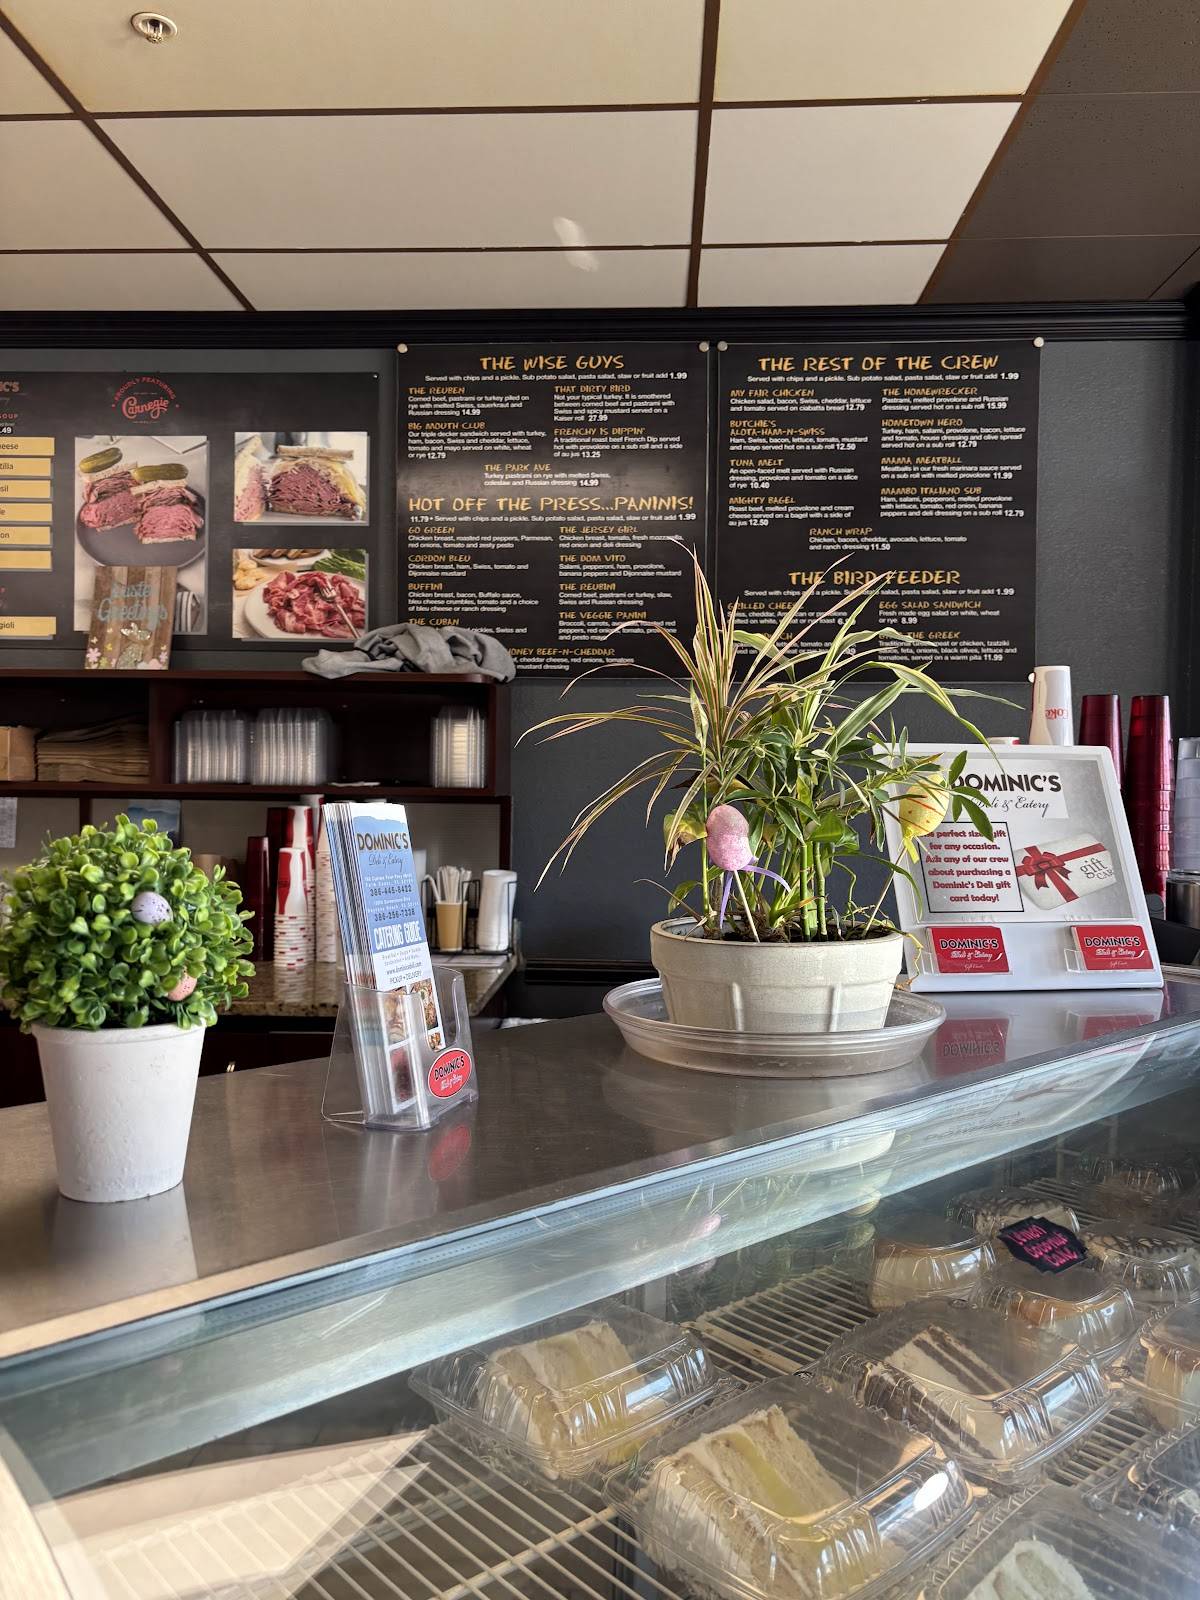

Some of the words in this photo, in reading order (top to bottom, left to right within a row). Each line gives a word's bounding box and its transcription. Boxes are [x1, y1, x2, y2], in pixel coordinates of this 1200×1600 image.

[480, 356, 515, 371] THE
[524, 356, 568, 370] WISE
[576, 355, 624, 370] GUYS
[759, 356, 794, 371] THE
[803, 356, 853, 371] REST
[862, 355, 887, 371] OF
[896, 355, 932, 370] THE
[941, 354, 999, 370] CREW
[114, 378, 140, 402] PROUDLY
[141, 376, 176, 400] FEATURING
[409, 387, 426, 395] THE
[429, 387, 465, 395] REUBEN
[554, 385, 575, 393] THAT
[580, 385, 606, 393] DIRTY
[610, 385, 630, 393] BIRD
[731, 389, 745, 397] MY
[749, 389, 768, 397] FAIR
[772, 389, 814, 397] CHICKEN
[883, 387, 900, 395] THE
[904, 387, 977, 395] HOMEWRECKER
[122, 396, 169, 419] Carnegie
[987, 402, 1006, 410] 15.99
[588, 414, 607, 422] 27.99
[408, 422, 422, 430] BIG
[426, 422, 458, 430] MOUTH
[462, 422, 485, 430] CLUB
[730, 420, 776, 428] BUTCHIE'S
[730, 428, 825, 436] ALOTA-HAM-N-SWISS
[730, 459, 754, 467] TUNA
[758, 459, 783, 467] MELT
[484, 463, 502, 472] THE
[505, 463, 528, 472] PARK
[533, 463, 550, 472] AVE
[580, 479, 598, 487] 14.99
[881, 487, 917, 495] MAMBO
[920, 487, 961, 495] ITALIANO
[964, 487, 981, 495] SUB
[409, 497, 444, 511] HOT
[453, 497, 486, 511] OFF
[496, 497, 532, 510] THE
[540, 497, 693, 510] PRESS...PANINIS!
[729, 496, 764, 504] MIGHTY
[768, 496, 795, 504] BAGEL
[411, 515, 429, 523] 11.79
[409, 526, 420, 534] GO
[424, 526, 454, 534] GREEN
[559, 526, 576, 534] THE
[580, 526, 613, 534] JERSEY
[617, 526, 638, 534] GIRL
[809, 528, 842, 536] RANCH
[845, 528, 872, 536] WRAP
[409, 554, 445, 562] CORDON
[449, 554, 470, 562] BLEU
[559, 554, 576, 562] THE
[580, 554, 601, 562] DOM
[605, 554, 626, 562] VITO
[789, 571, 825, 585] THE
[834, 571, 877, 585] BIRD
[559, 583, 576, 591] THE
[580, 583, 615, 591] REUBINI
[879, 601, 897, 609] EGG
[900, 601, 929, 609] SALAD
[933, 601, 981, 609] SANDWICH
[559, 611, 576, 619] THE
[579, 611, 612, 619] VEGGIE
[616, 611, 646, 619] PANINI
[410, 618, 426, 626] THE
[430, 618, 459, 626] CUBAN
[929, 631, 960, 639] GREEK
[537, 648, 615, 656] BEEF-N-CHEDDAR
[949, 773, 1061, 792] DOMINIC'S
[1002, 799, 1012, 810] &
[1015, 796, 1050, 818] Eatery
[937, 830, 966, 840] perfect
[357, 833, 408, 850] DOMINIC'S
[929, 842, 941, 850] for
[944, 844, 961, 853] any
[963, 842, 1000, 850] occasion.
[926, 855, 942, 863] Ask
[944, 857, 961, 866] any
[963, 855, 970, 863] of
[1080, 858, 1105, 879] gift
[928, 868, 953, 876] about
[956, 868, 1003, 878] purchasing
[933, 881, 974, 889] Dominic's
[977, 881, 994, 889] Deli
[996, 881, 1011, 891] gift
[950, 894, 969, 902] card
[971, 894, 999, 904] today!
[374, 924, 403, 950] CATERING
[404, 921, 421, 943] GUIDE
[940, 938, 998, 950] DOMINIC'S
[1085, 936, 1140, 948] DOMINIC'S
[435, 1056, 464, 1080] DOMINIC'S
